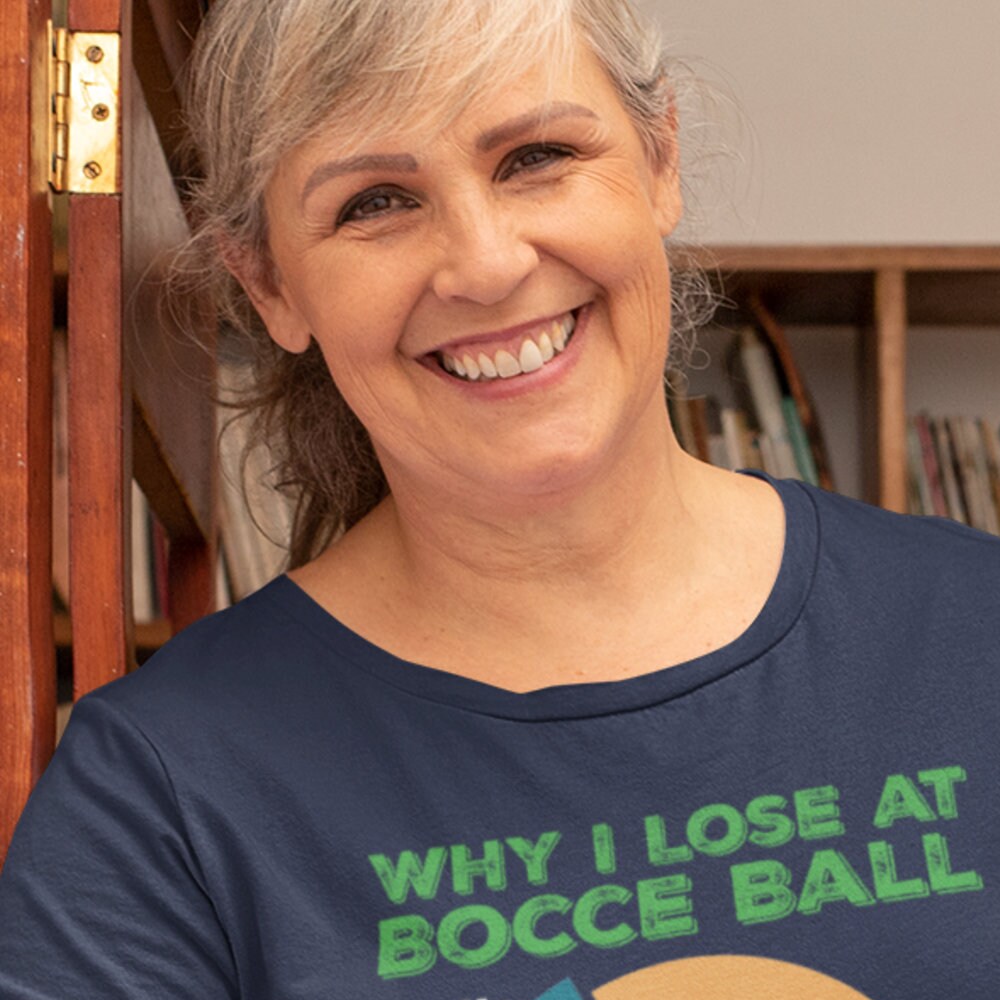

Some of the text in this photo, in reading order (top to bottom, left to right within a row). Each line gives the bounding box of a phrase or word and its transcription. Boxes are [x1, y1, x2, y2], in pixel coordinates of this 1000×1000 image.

[368, 765, 967, 905] WHY I LOSE AT
[376, 832, 984, 980] BOCCE BALL
